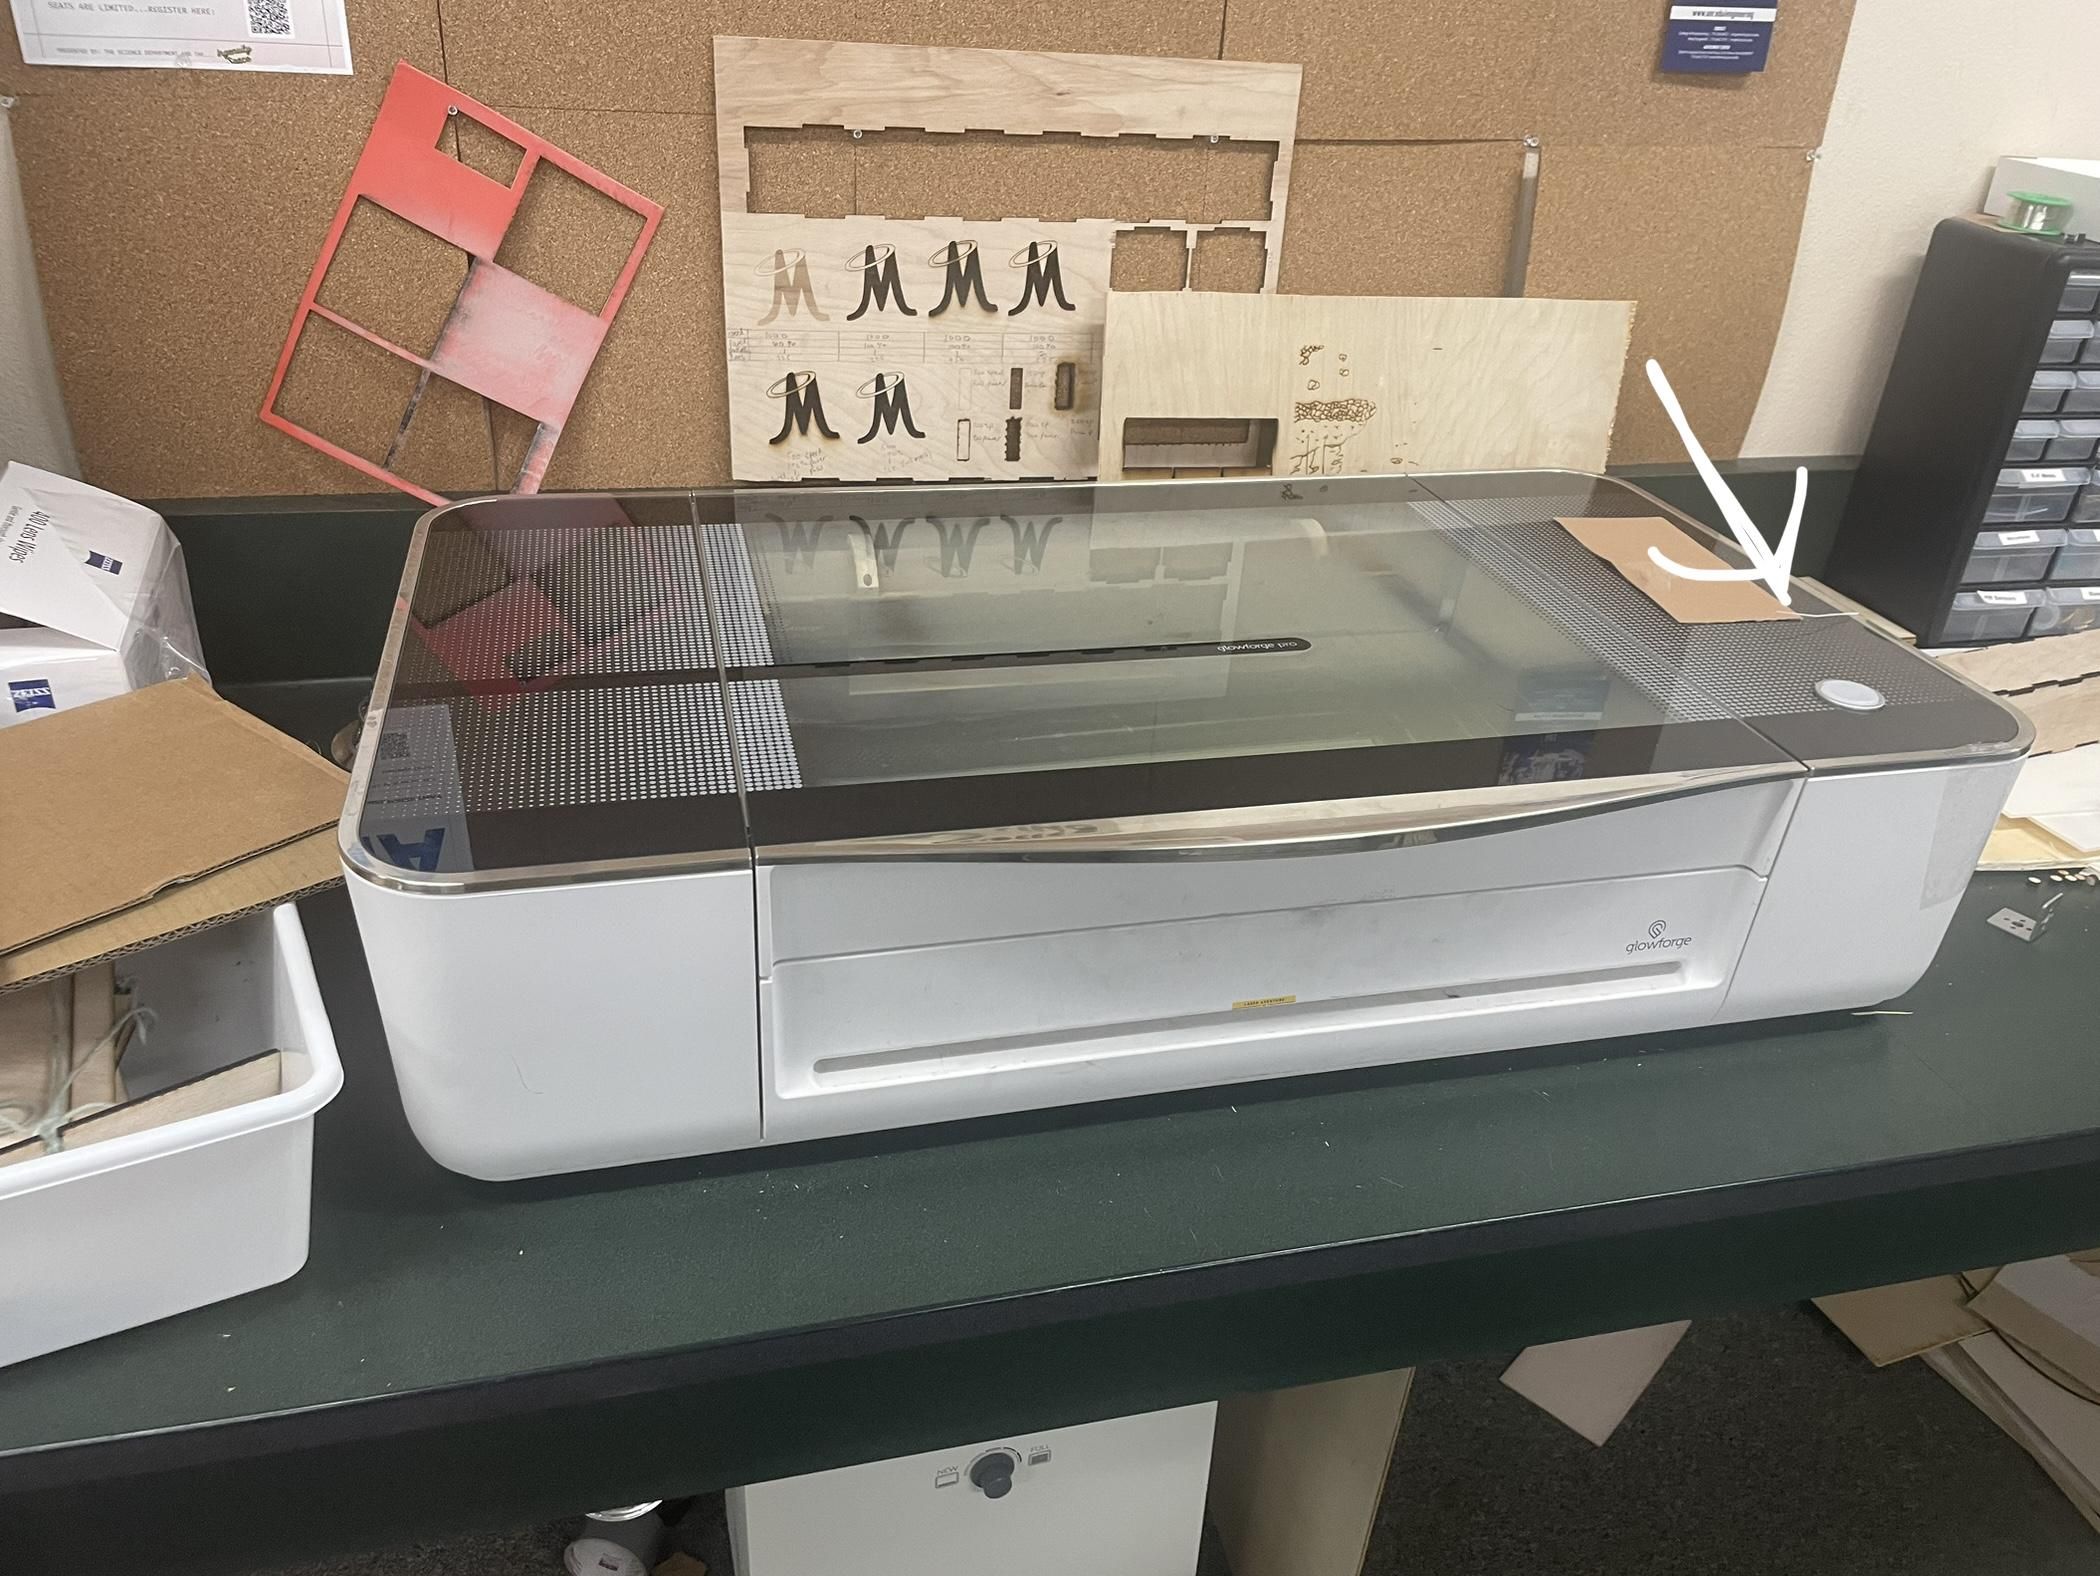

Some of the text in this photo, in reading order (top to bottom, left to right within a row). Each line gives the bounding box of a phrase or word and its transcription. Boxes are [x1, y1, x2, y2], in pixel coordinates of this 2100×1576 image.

[47, 1, 75, 10] SEATS
[78, 3, 95, 11] ARE
[8, 511, 50, 563] 400 Lens Wipes
[1216, 641, 1298, 652] glowforge pro
[1625, 937, 1692, 955] glowforge
